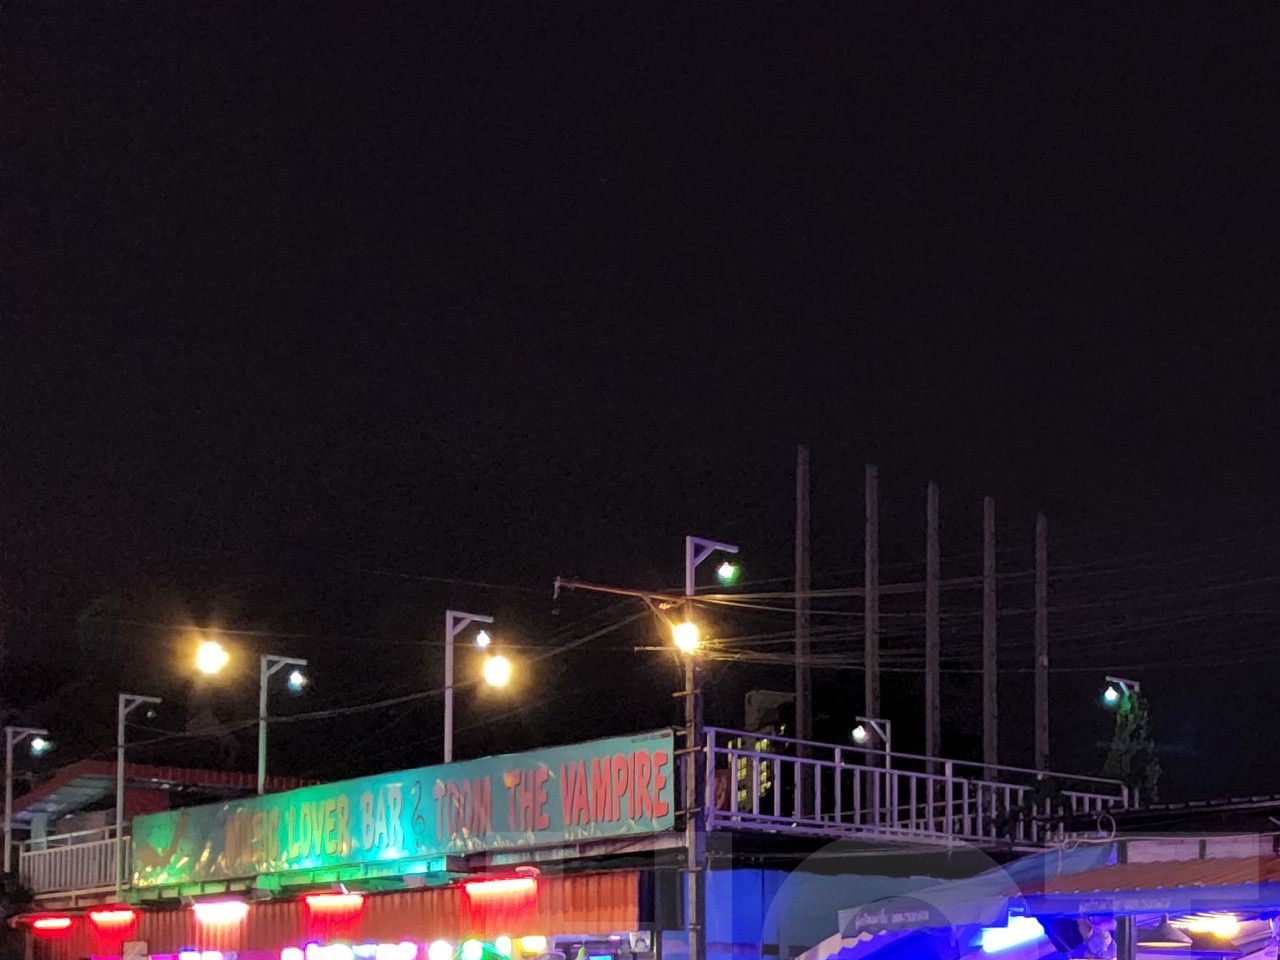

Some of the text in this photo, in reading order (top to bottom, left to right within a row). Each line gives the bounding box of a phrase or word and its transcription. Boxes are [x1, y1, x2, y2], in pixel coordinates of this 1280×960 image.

[287, 793, 350, 859] LOVER
[359, 782, 405, 850] BAR
[433, 775, 493, 842] TOOM
[503, 766, 551, 832] THE
[560, 748, 670, 827] VAMPIRE
